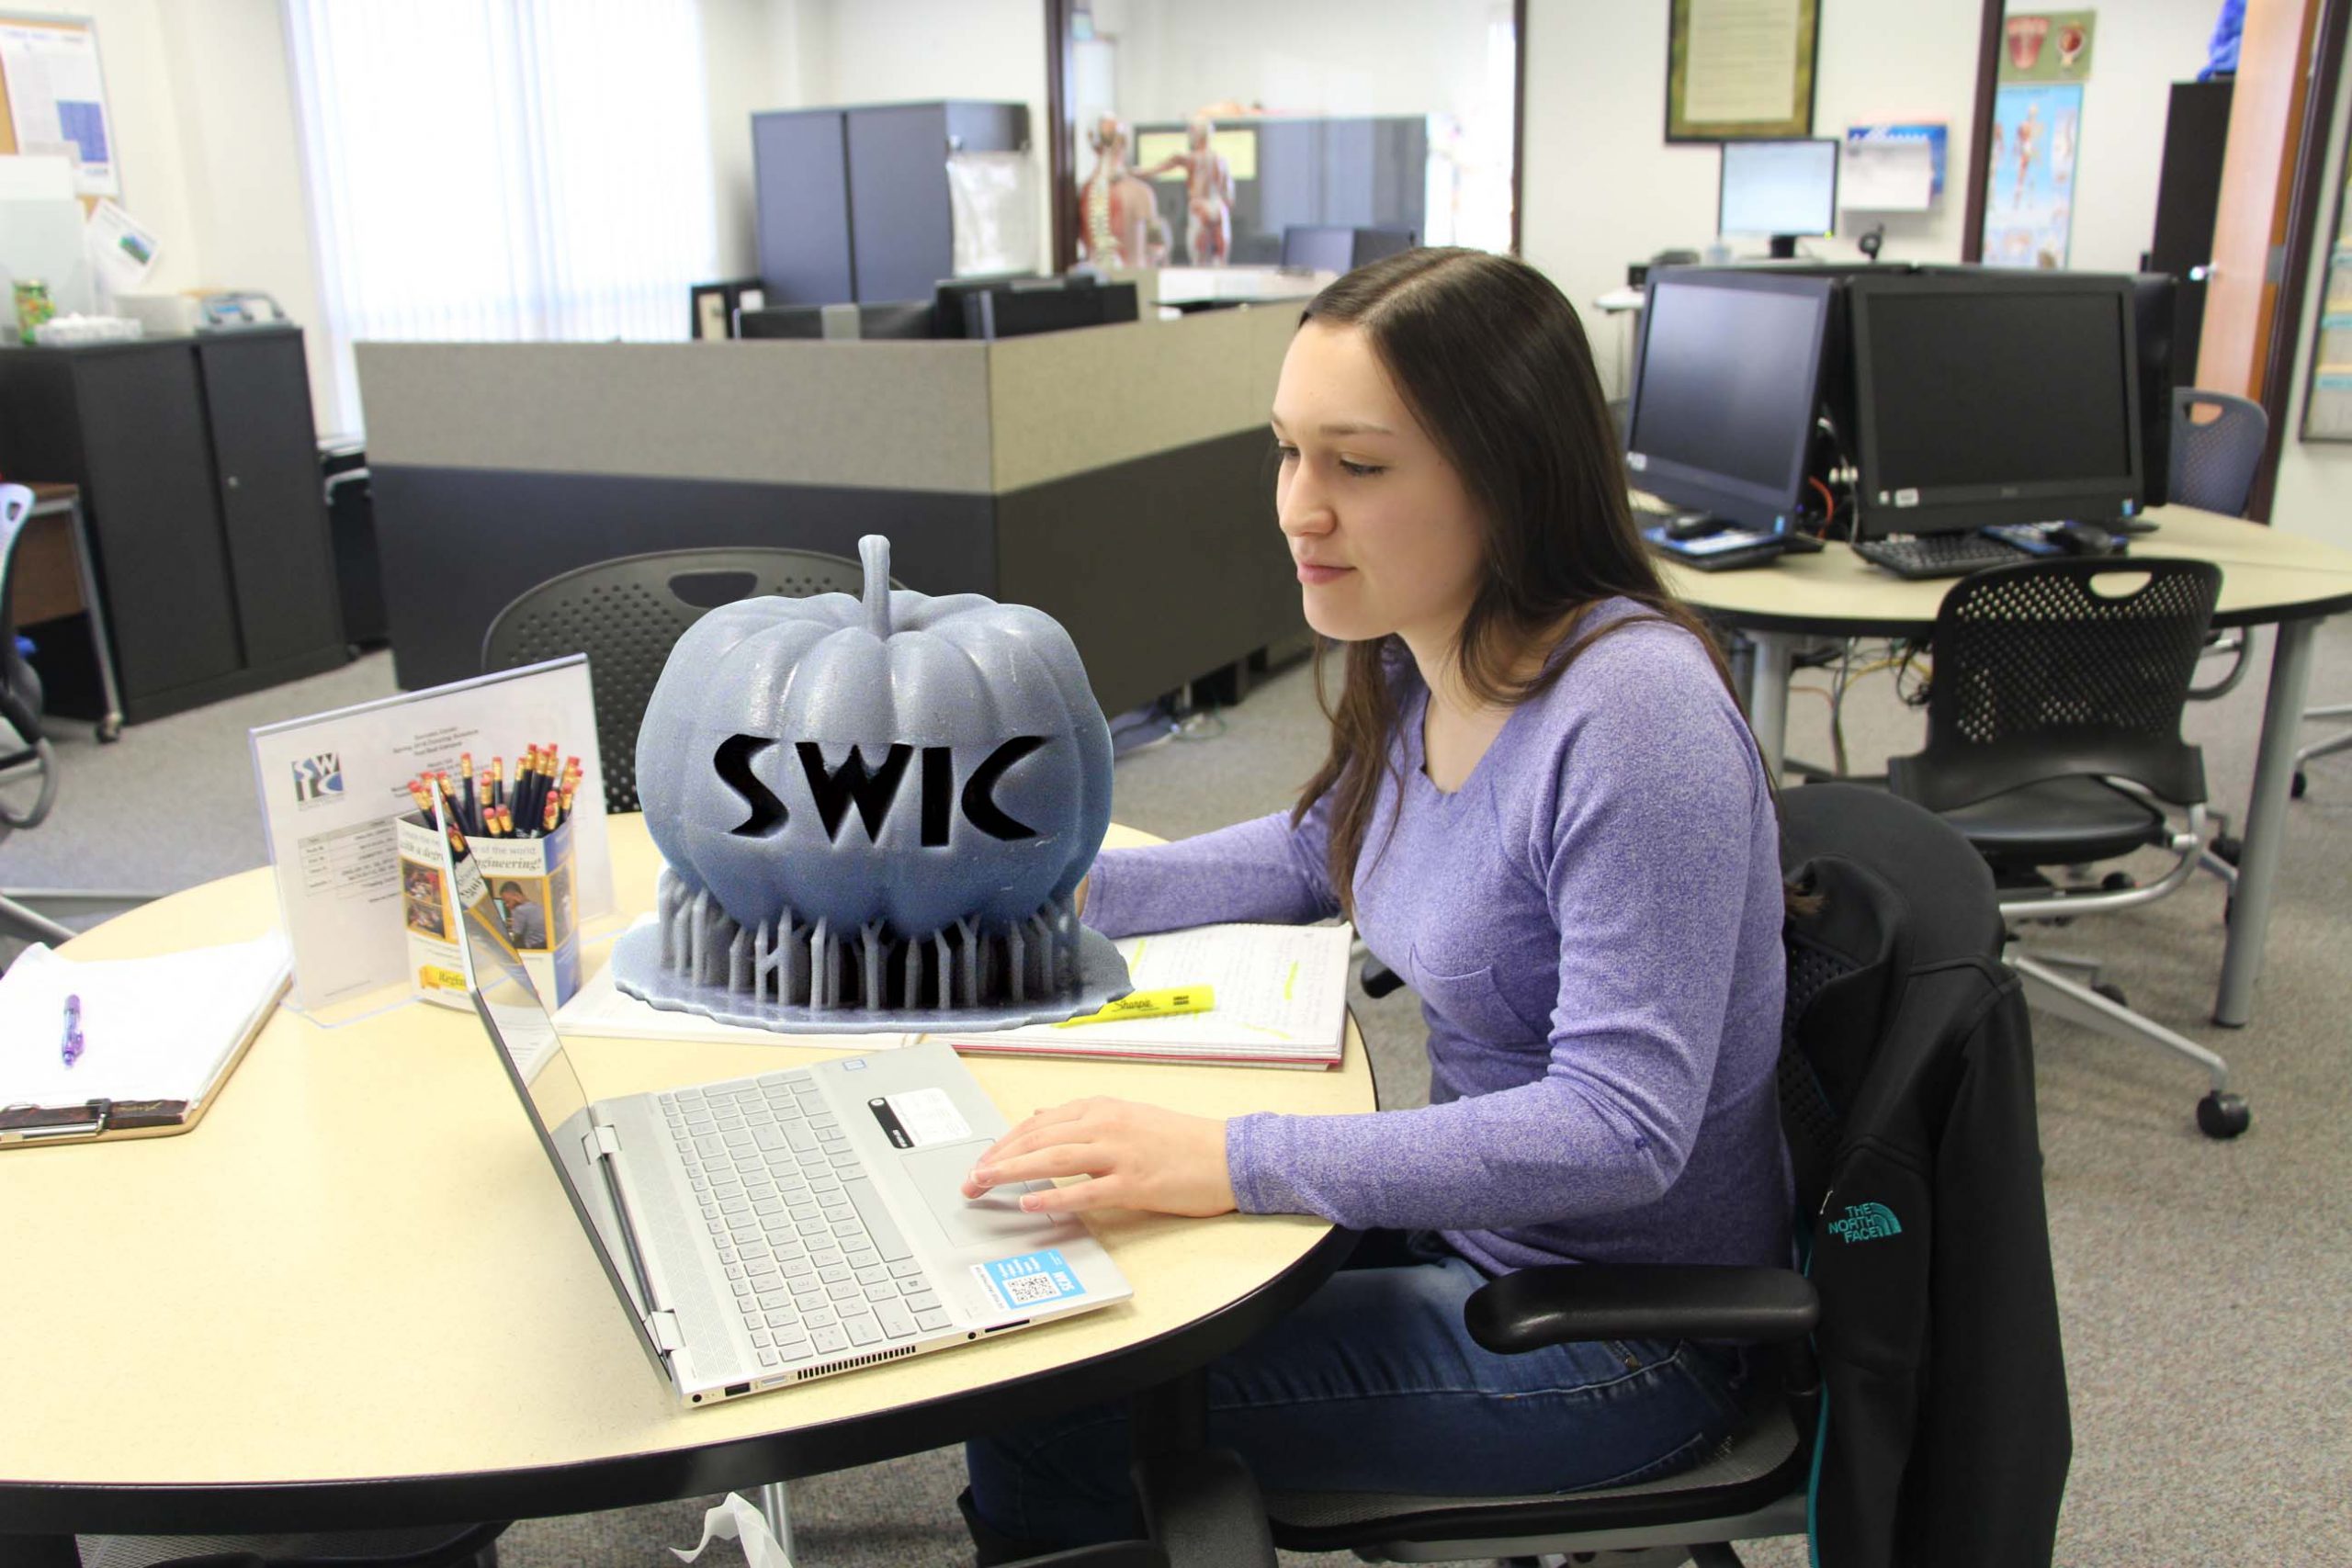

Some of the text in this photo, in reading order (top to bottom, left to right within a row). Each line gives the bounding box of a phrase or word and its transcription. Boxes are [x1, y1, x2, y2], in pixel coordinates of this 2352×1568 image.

[714, 733, 1056, 847] SWIC
[1113, 998, 1158, 1012] Sharpie
[1845, 1202, 1872, 1218] THE
[1828, 1216, 1875, 1235] NORTH
[1844, 1226, 1877, 1244] FACE
[1051, 1269, 1075, 1292] SCAN
